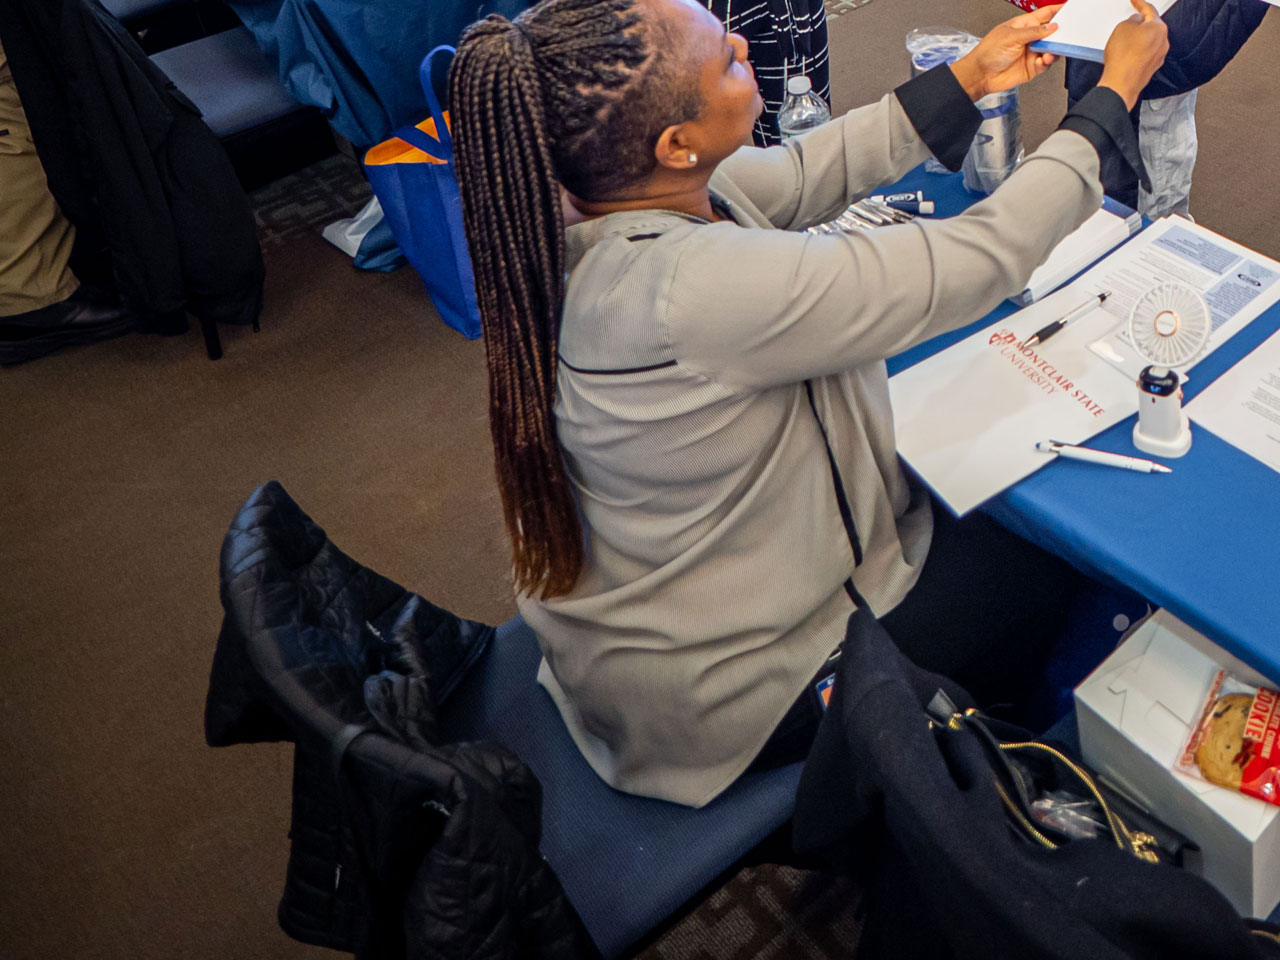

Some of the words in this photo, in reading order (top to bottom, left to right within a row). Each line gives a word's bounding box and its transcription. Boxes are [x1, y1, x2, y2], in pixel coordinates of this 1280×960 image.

[1000, 347, 1059, 396] UNIVERSITY
[1013, 340, 1074, 392] MONTCLAIR
[1071, 389, 1106, 418] STATE
[1261, 729, 1276, 759] CHUNK
